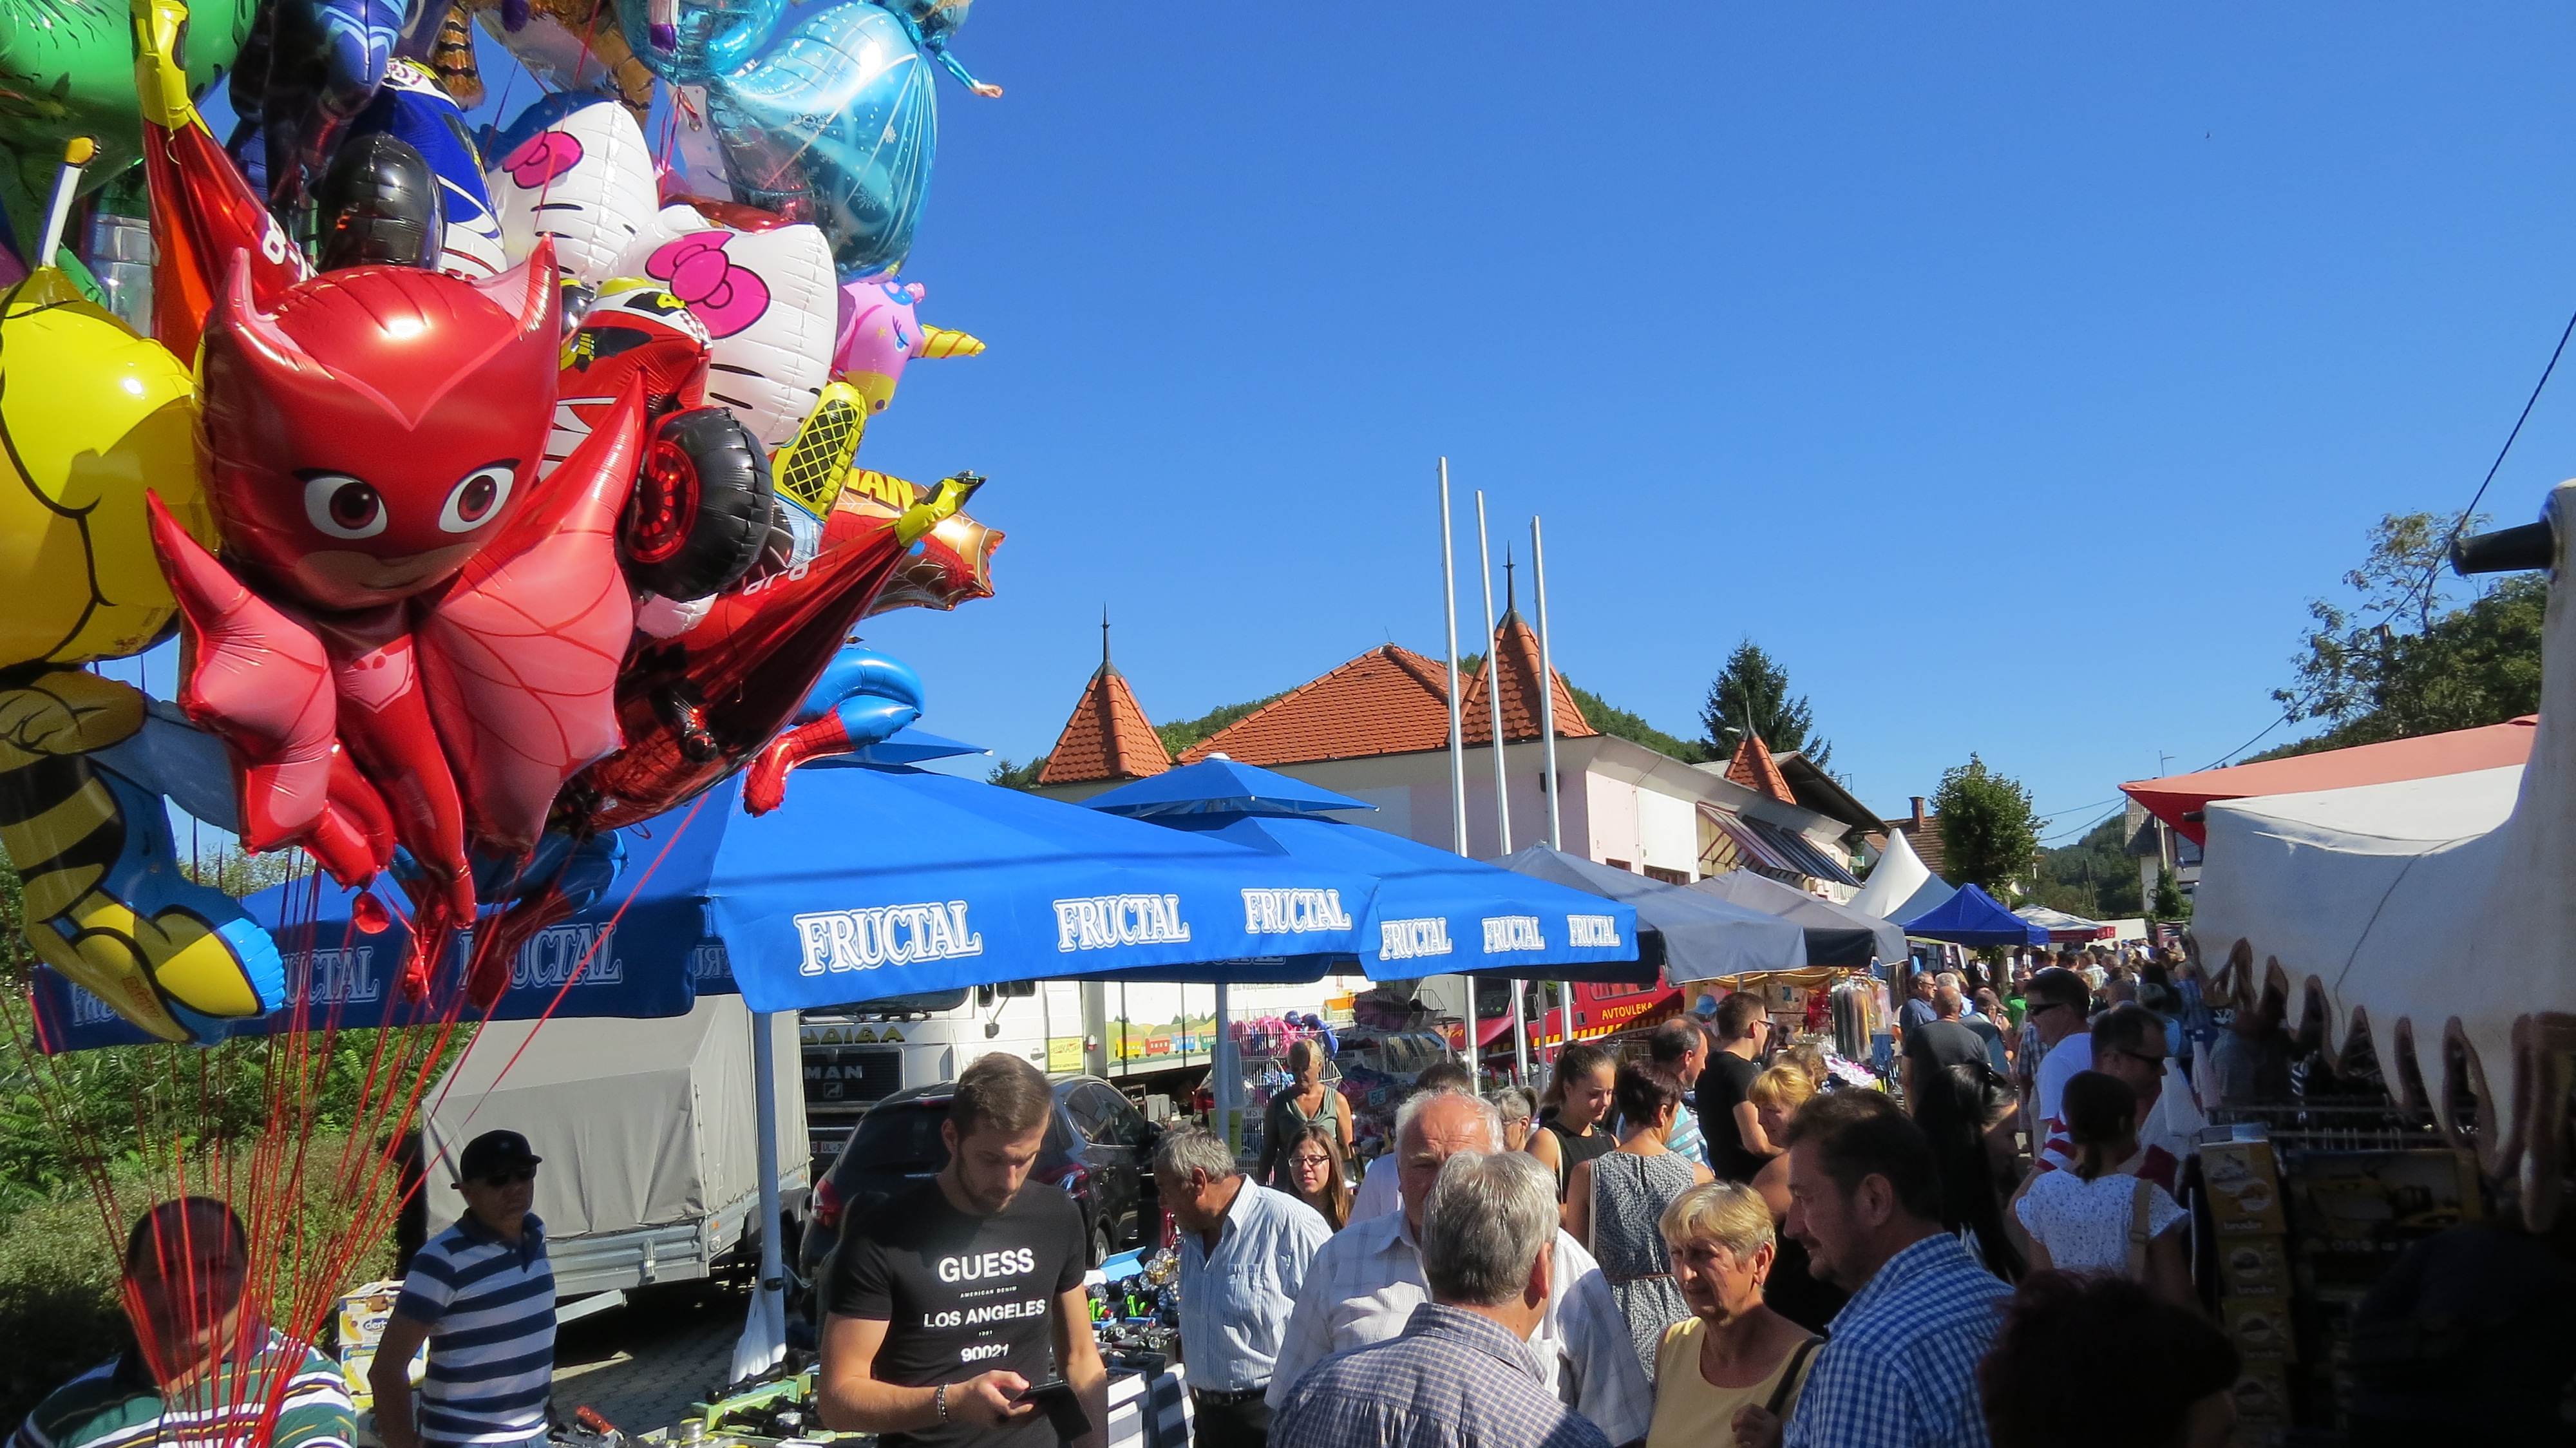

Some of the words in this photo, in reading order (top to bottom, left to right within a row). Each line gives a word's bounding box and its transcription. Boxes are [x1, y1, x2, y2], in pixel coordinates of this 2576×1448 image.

[1053, 893, 1191, 953] FRUCTAL
[1240, 888, 1352, 934] FRUCTAL
[793, 900, 983, 976] FRUCTAL
[1379, 917, 1452, 961] FRUCTAL
[1481, 915, 1545, 953] FRUCTAL
[1566, 914, 1621, 948] FRUCTAL
[1602, 1002, 1653, 1020] AVTOVLEKA
[805, 1065, 862, 1079] MAN
[2223, 1220, 2264, 1230] bruder
[938, 1248, 1035, 1282] GUESS
[960, 1290, 994, 1299] AMERICAN
[923, 1310, 961, 1328] LOS
[965, 1299, 1046, 1325] ANGELES
[960, 1344, 1009, 1363] 90021
